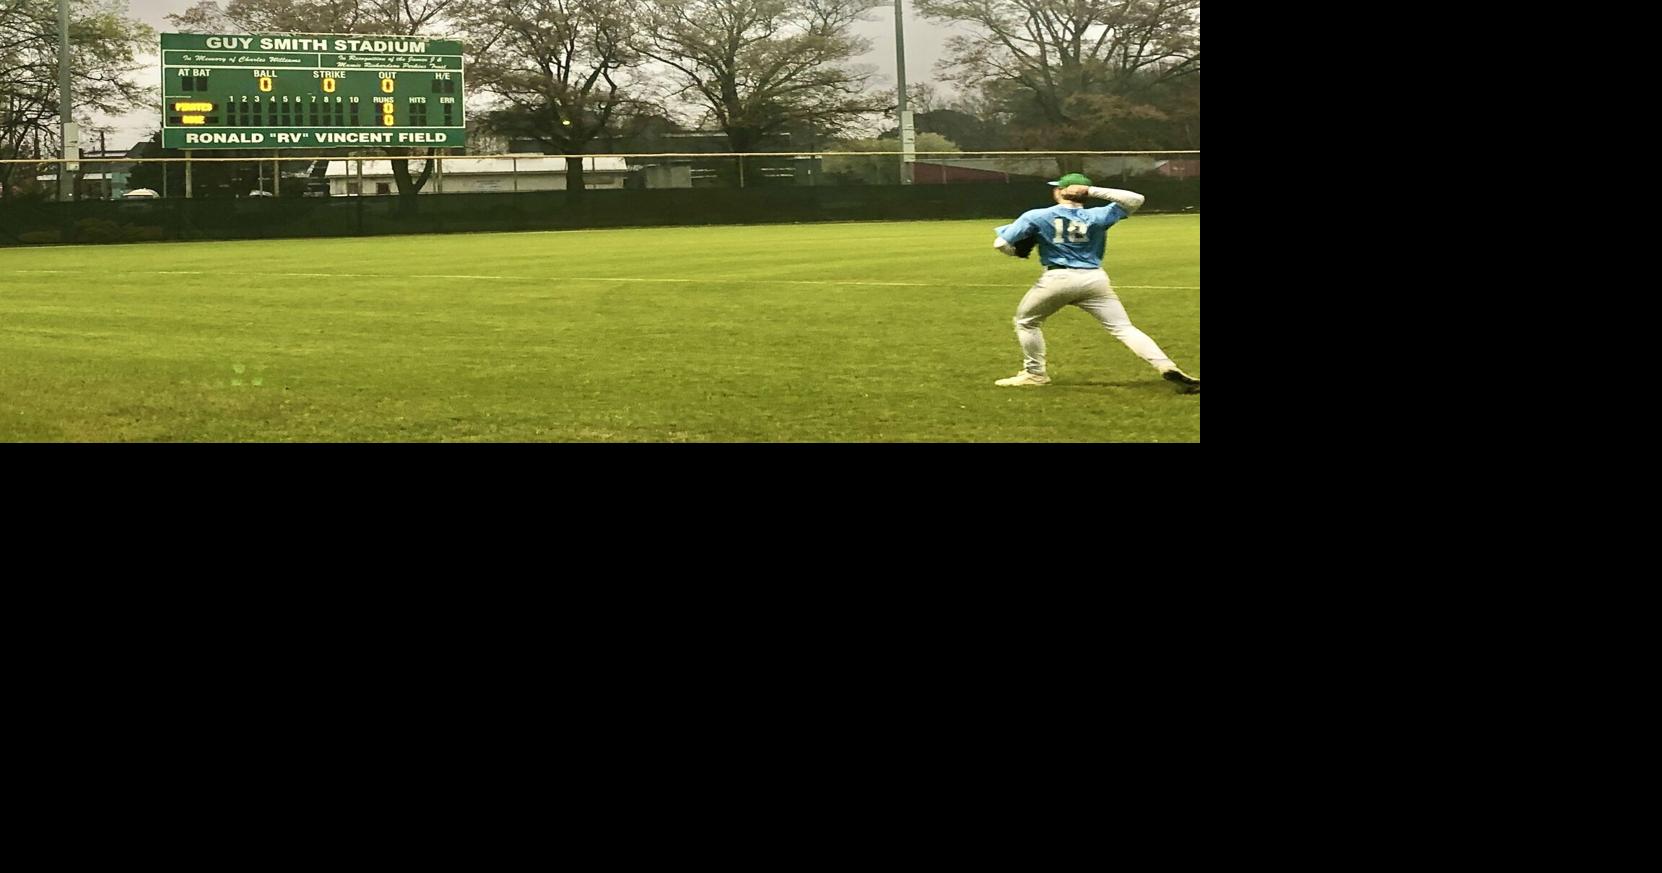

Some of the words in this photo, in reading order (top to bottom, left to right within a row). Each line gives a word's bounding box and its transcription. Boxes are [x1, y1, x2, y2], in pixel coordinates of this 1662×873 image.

[206, 37, 253, 49] GUY
[260, 38, 327, 51] SMITH
[334, 40, 426, 53] STADIUM
[193, 69, 211, 77] BAT
[260, 78, 272, 92] 0
[323, 78, 335, 92] 0
[382, 79, 394, 93] 0
[383, 103, 394, 114] 0
[383, 115, 394, 126] 0
[186, 133, 264, 143] RONALD
[270, 133, 308, 143] "RV"
[315, 133, 393, 143] VINCENT
[399, 133, 447, 142] FIELD
